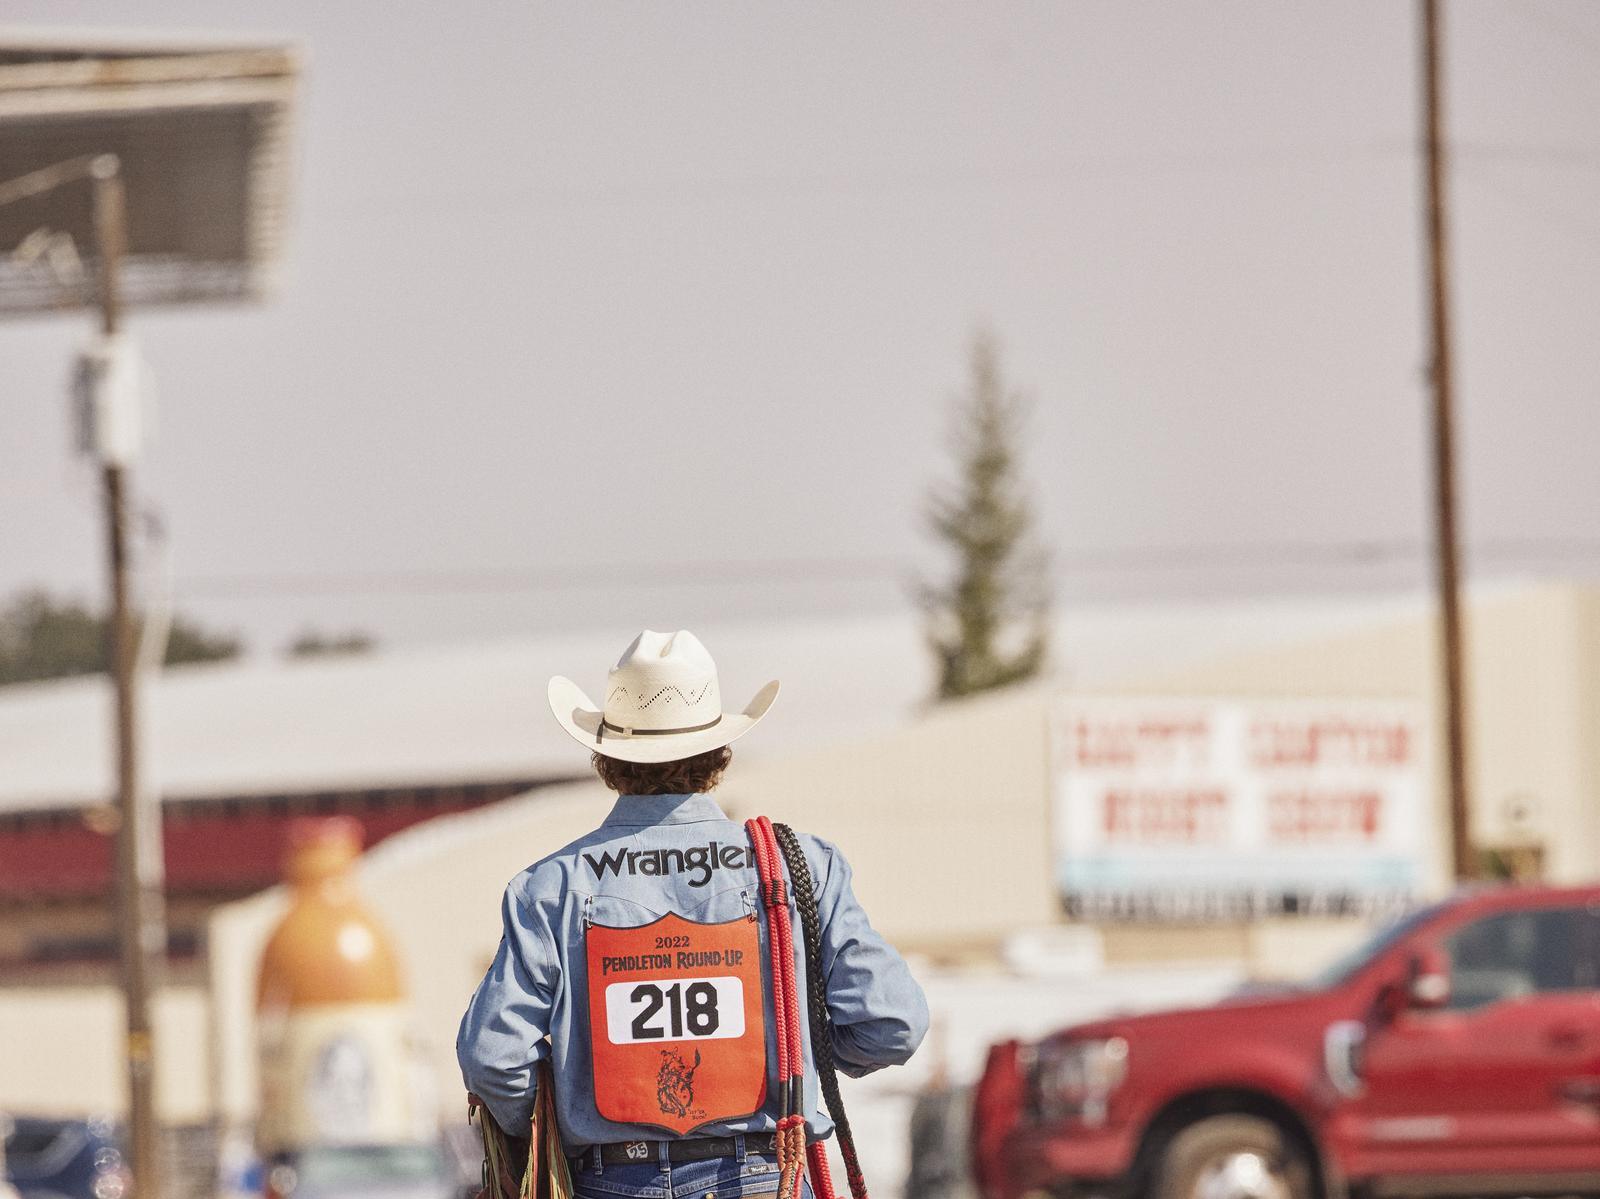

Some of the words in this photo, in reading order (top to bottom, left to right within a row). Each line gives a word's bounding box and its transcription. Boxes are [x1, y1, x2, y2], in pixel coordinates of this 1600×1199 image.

[655, 936, 690, 949] 2022
[602, 953, 672, 976] PENDLETON
[630, 981, 720, 1040] 218
